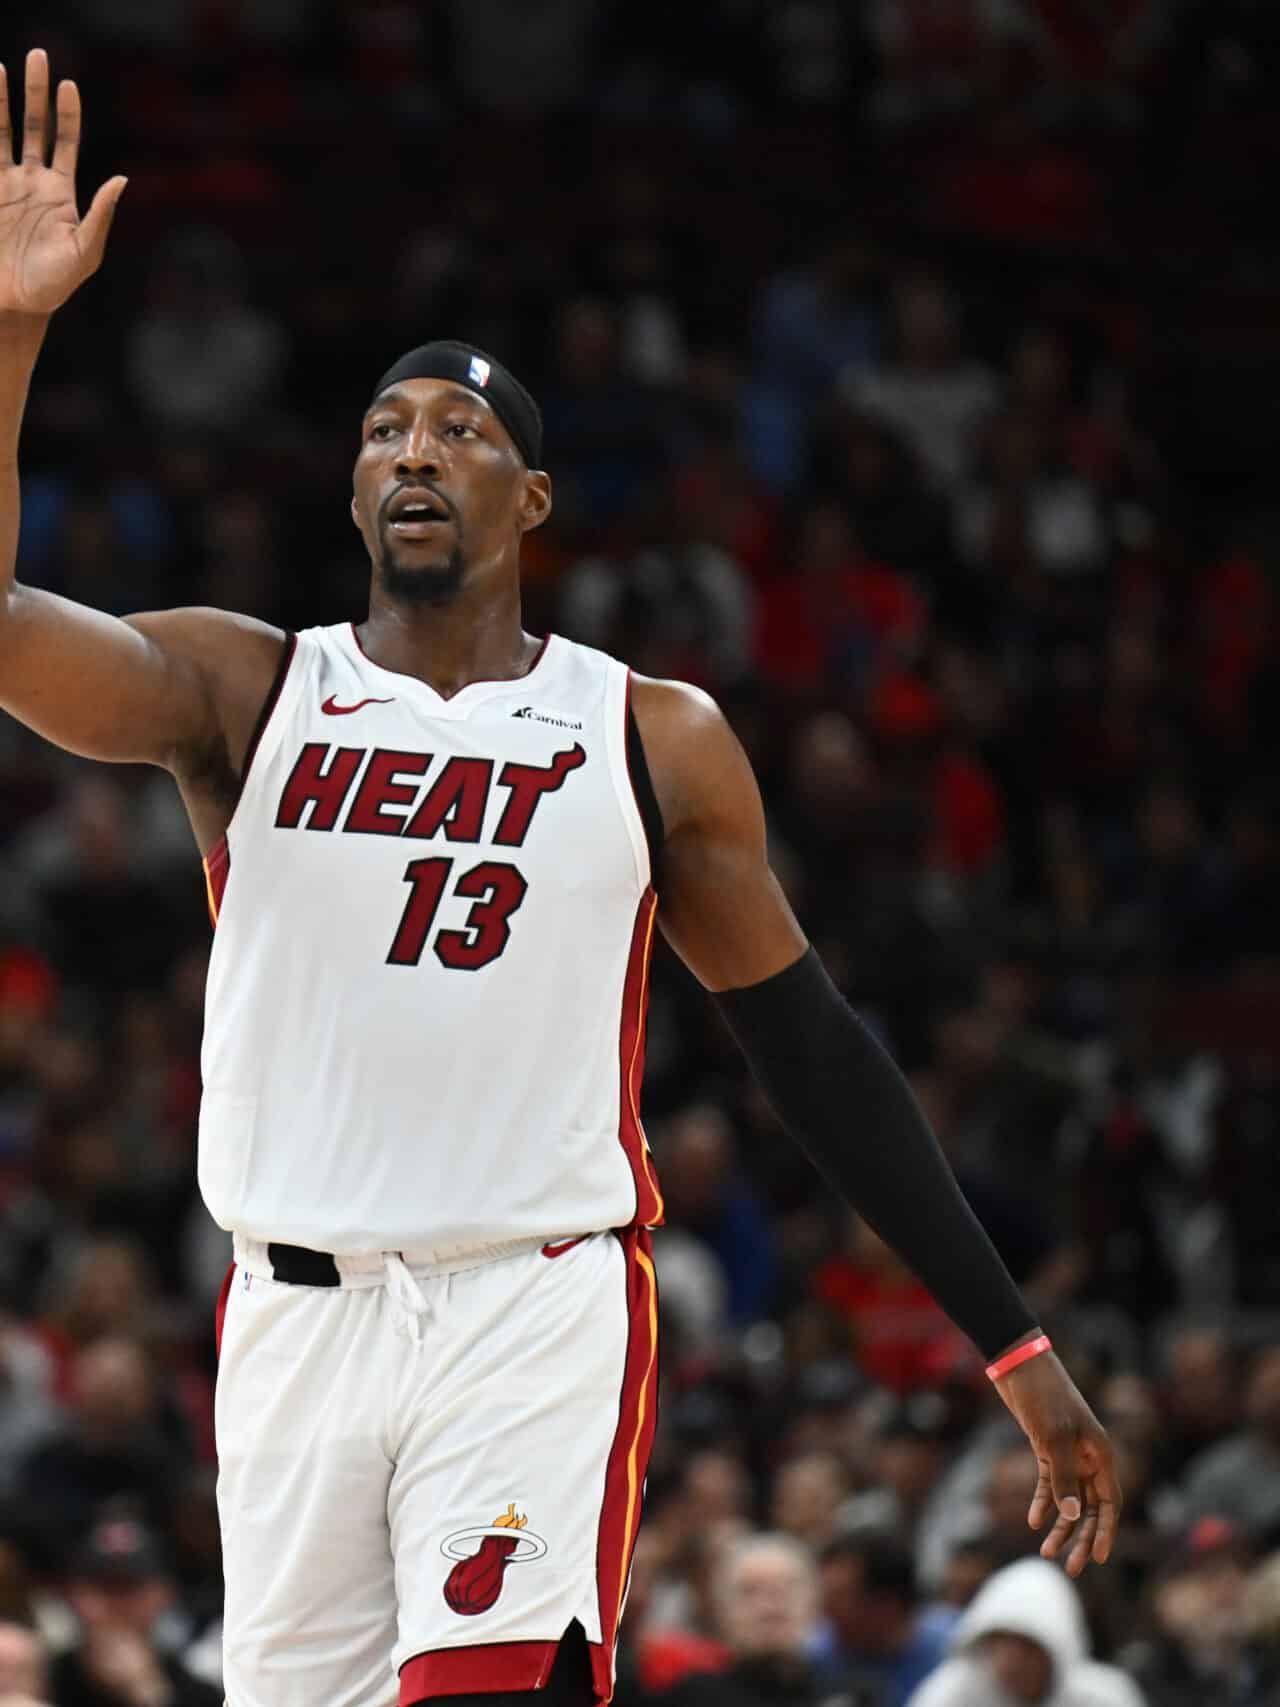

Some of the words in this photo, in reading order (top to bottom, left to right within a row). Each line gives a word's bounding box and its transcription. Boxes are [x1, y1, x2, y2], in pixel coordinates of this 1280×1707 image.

[526, 711, 583, 731] Carnival
[274, 741, 587, 848] HEAT
[385, 856, 529, 971] 13
